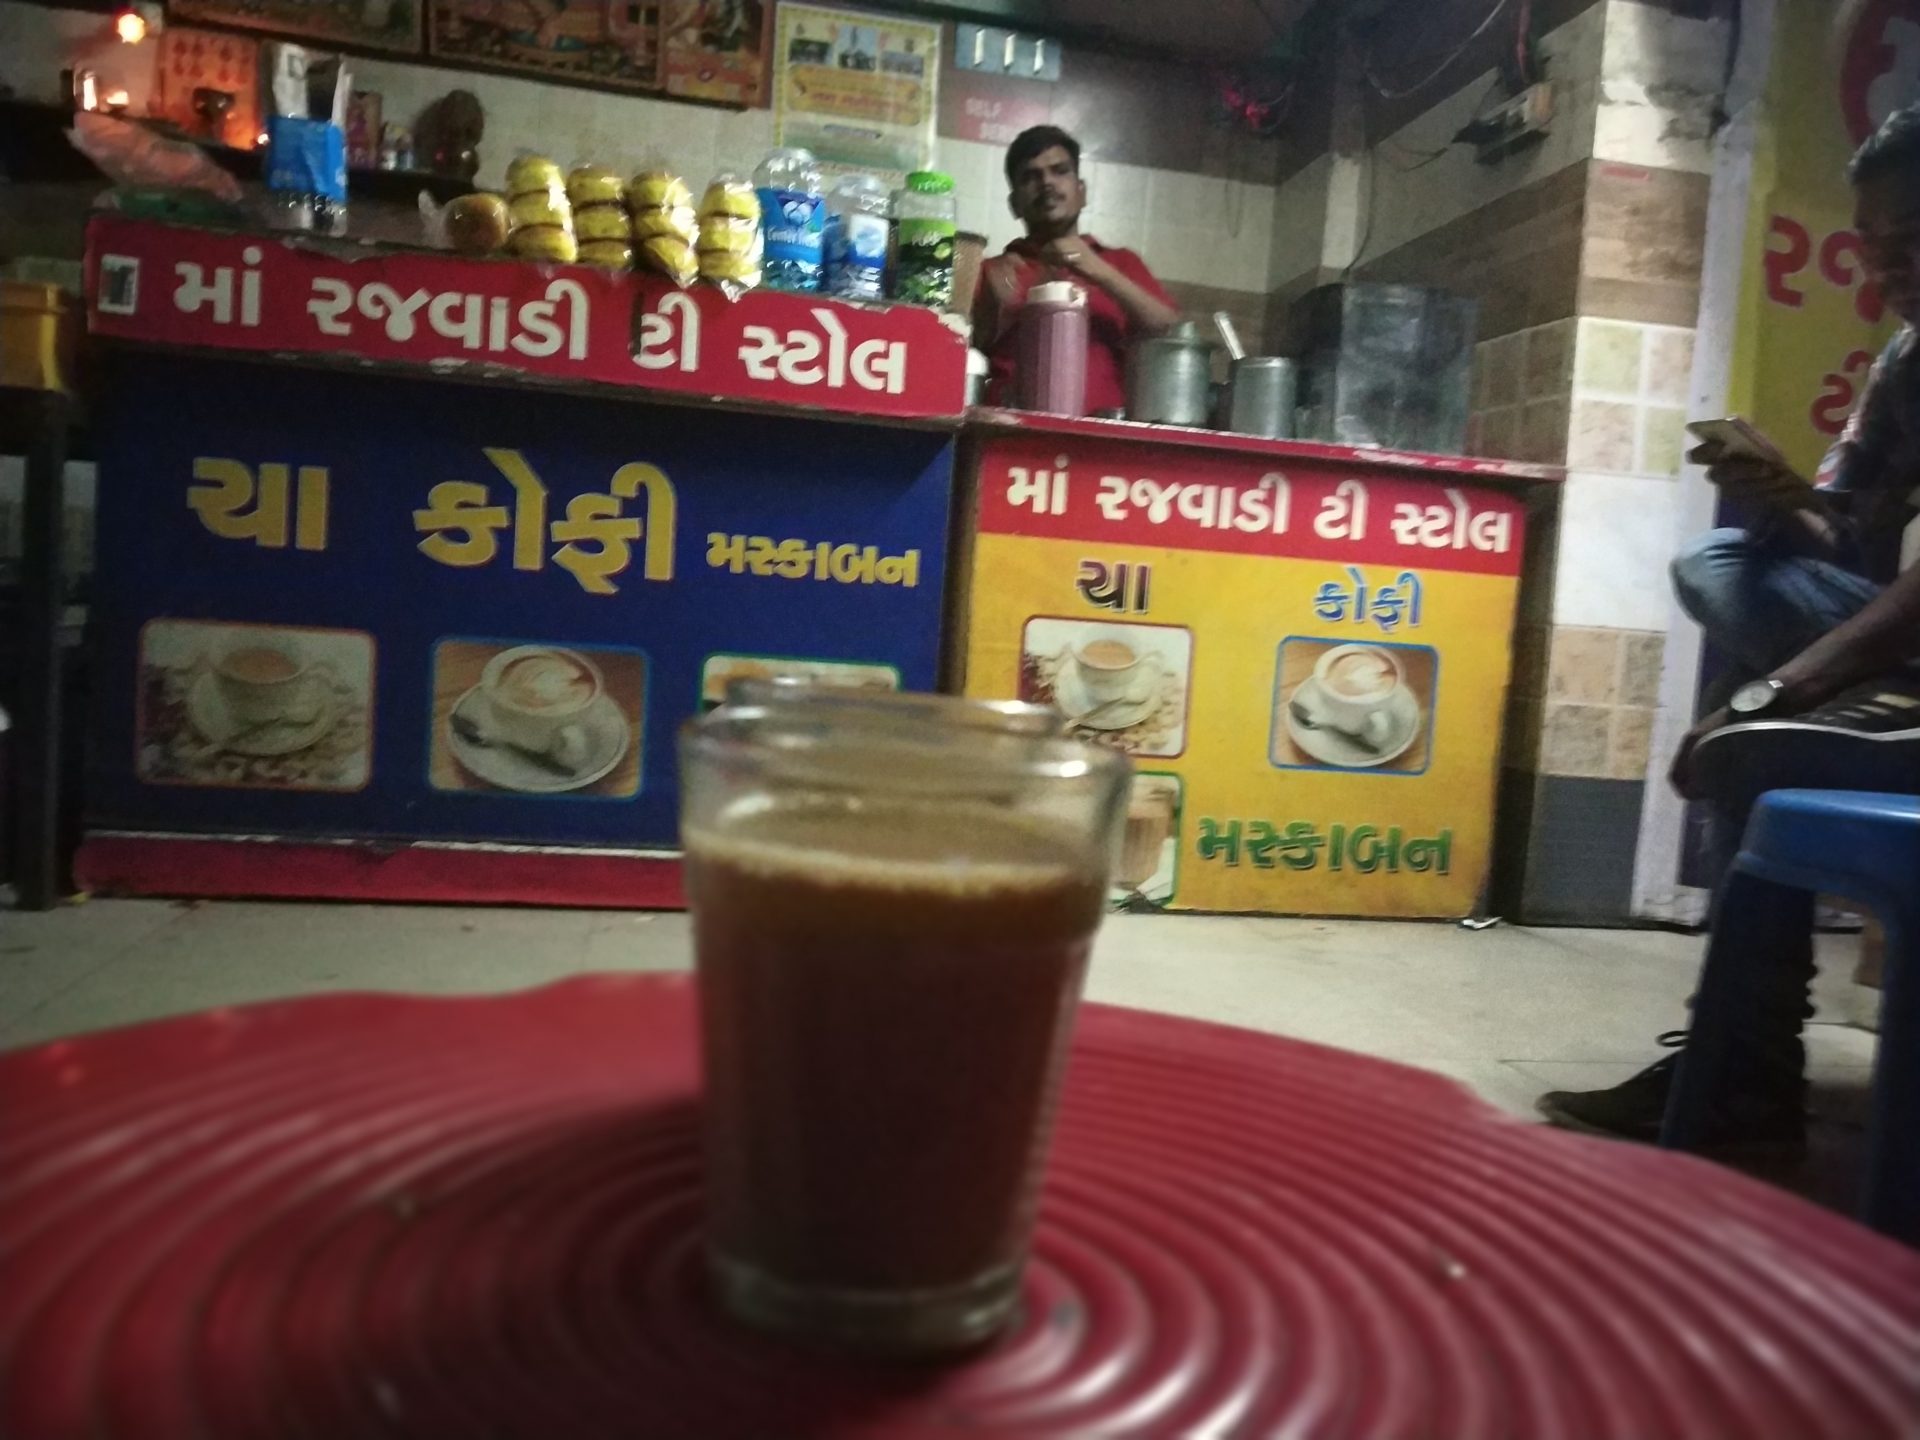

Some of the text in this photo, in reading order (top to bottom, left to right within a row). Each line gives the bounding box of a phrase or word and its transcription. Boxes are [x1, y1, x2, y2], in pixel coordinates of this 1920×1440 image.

[173, 246, 908, 395] માં રજવાડી ટી સ્ટોલ
[187, 447, 921, 595] ચા કોફી મસ્કાબન
[1006, 454, 1512, 554] માં રજવાડી ટી સ્ટોલ
[1076, 559, 1422, 634] ચા કોફી
[1197, 816, 1452, 875] મસ્કાબન
